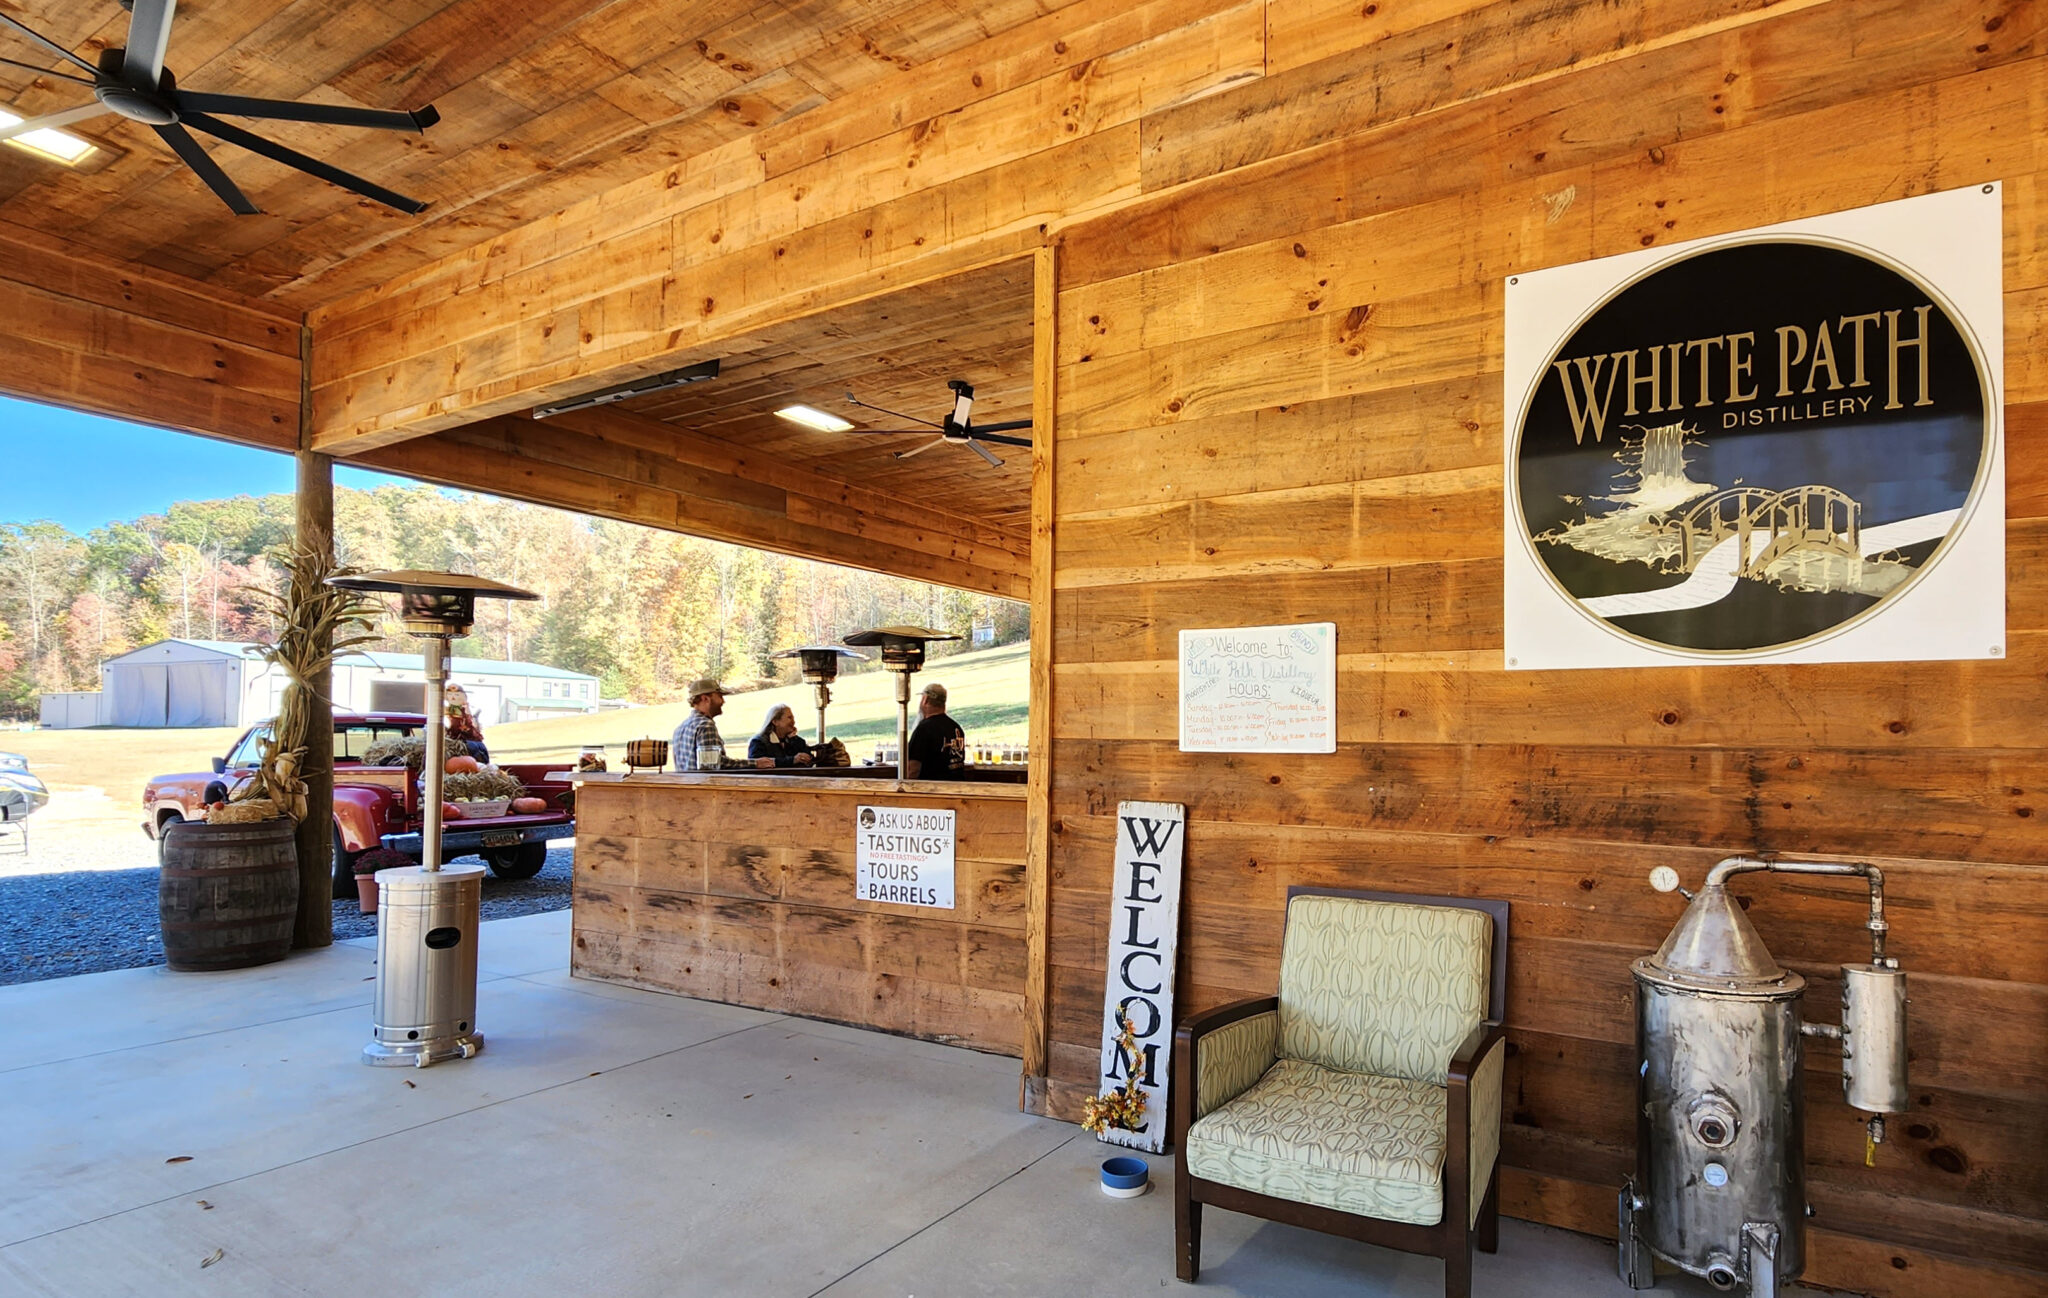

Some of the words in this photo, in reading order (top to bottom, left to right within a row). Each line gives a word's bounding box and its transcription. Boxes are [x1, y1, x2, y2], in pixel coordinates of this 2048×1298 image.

[1553, 331, 1759, 446] WHITE
[1774, 304, 1934, 410] PATH
[1722, 394, 1874, 429] DISTILLERY
[1214, 636, 1268, 655] Welcome
[879, 813, 898, 828] ASK
[900, 814, 913, 829] US
[916, 815, 952, 831] ABOUT
[868, 862, 918, 882] TOURS
[869, 883, 936, 905] BARRELS
